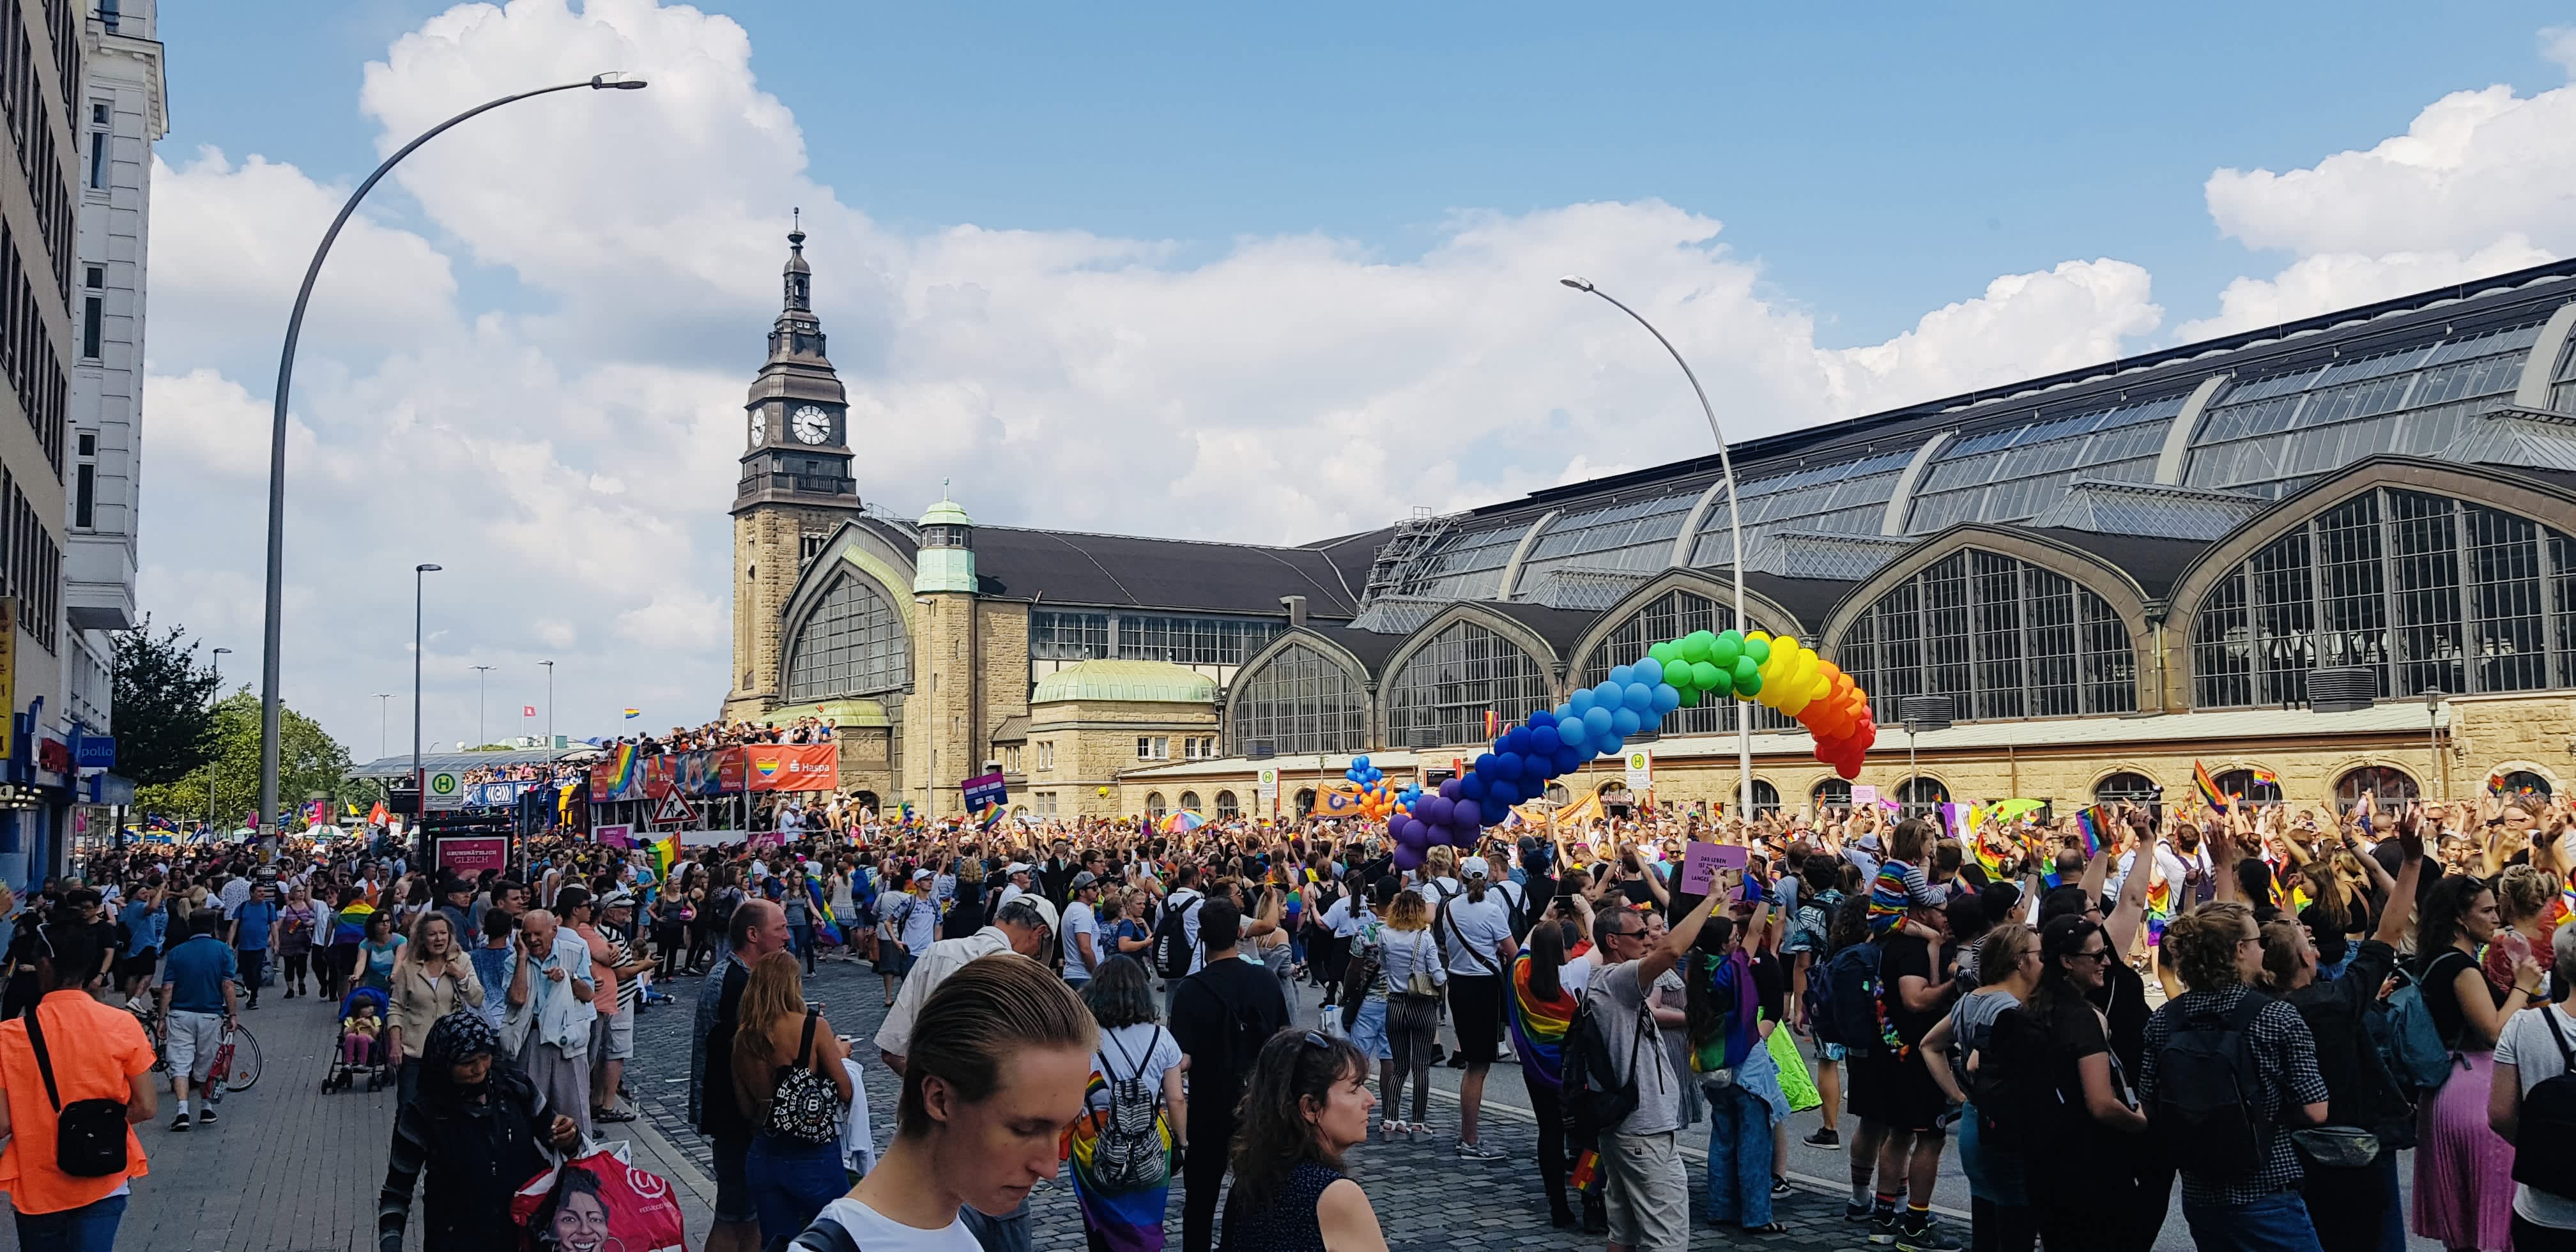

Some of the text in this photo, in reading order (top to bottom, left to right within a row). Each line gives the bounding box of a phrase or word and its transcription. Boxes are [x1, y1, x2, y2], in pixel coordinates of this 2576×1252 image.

[81, 745, 114, 758] pollo
[802, 763, 830, 773] Haspa
[438, 778, 449, 790] H
[790, 1082, 806, 1111] BERLIN
[779, 1088, 793, 1131] BERLIN
[808, 1099, 819, 1111] B
[792, 1115, 818, 1133] BERLIN
